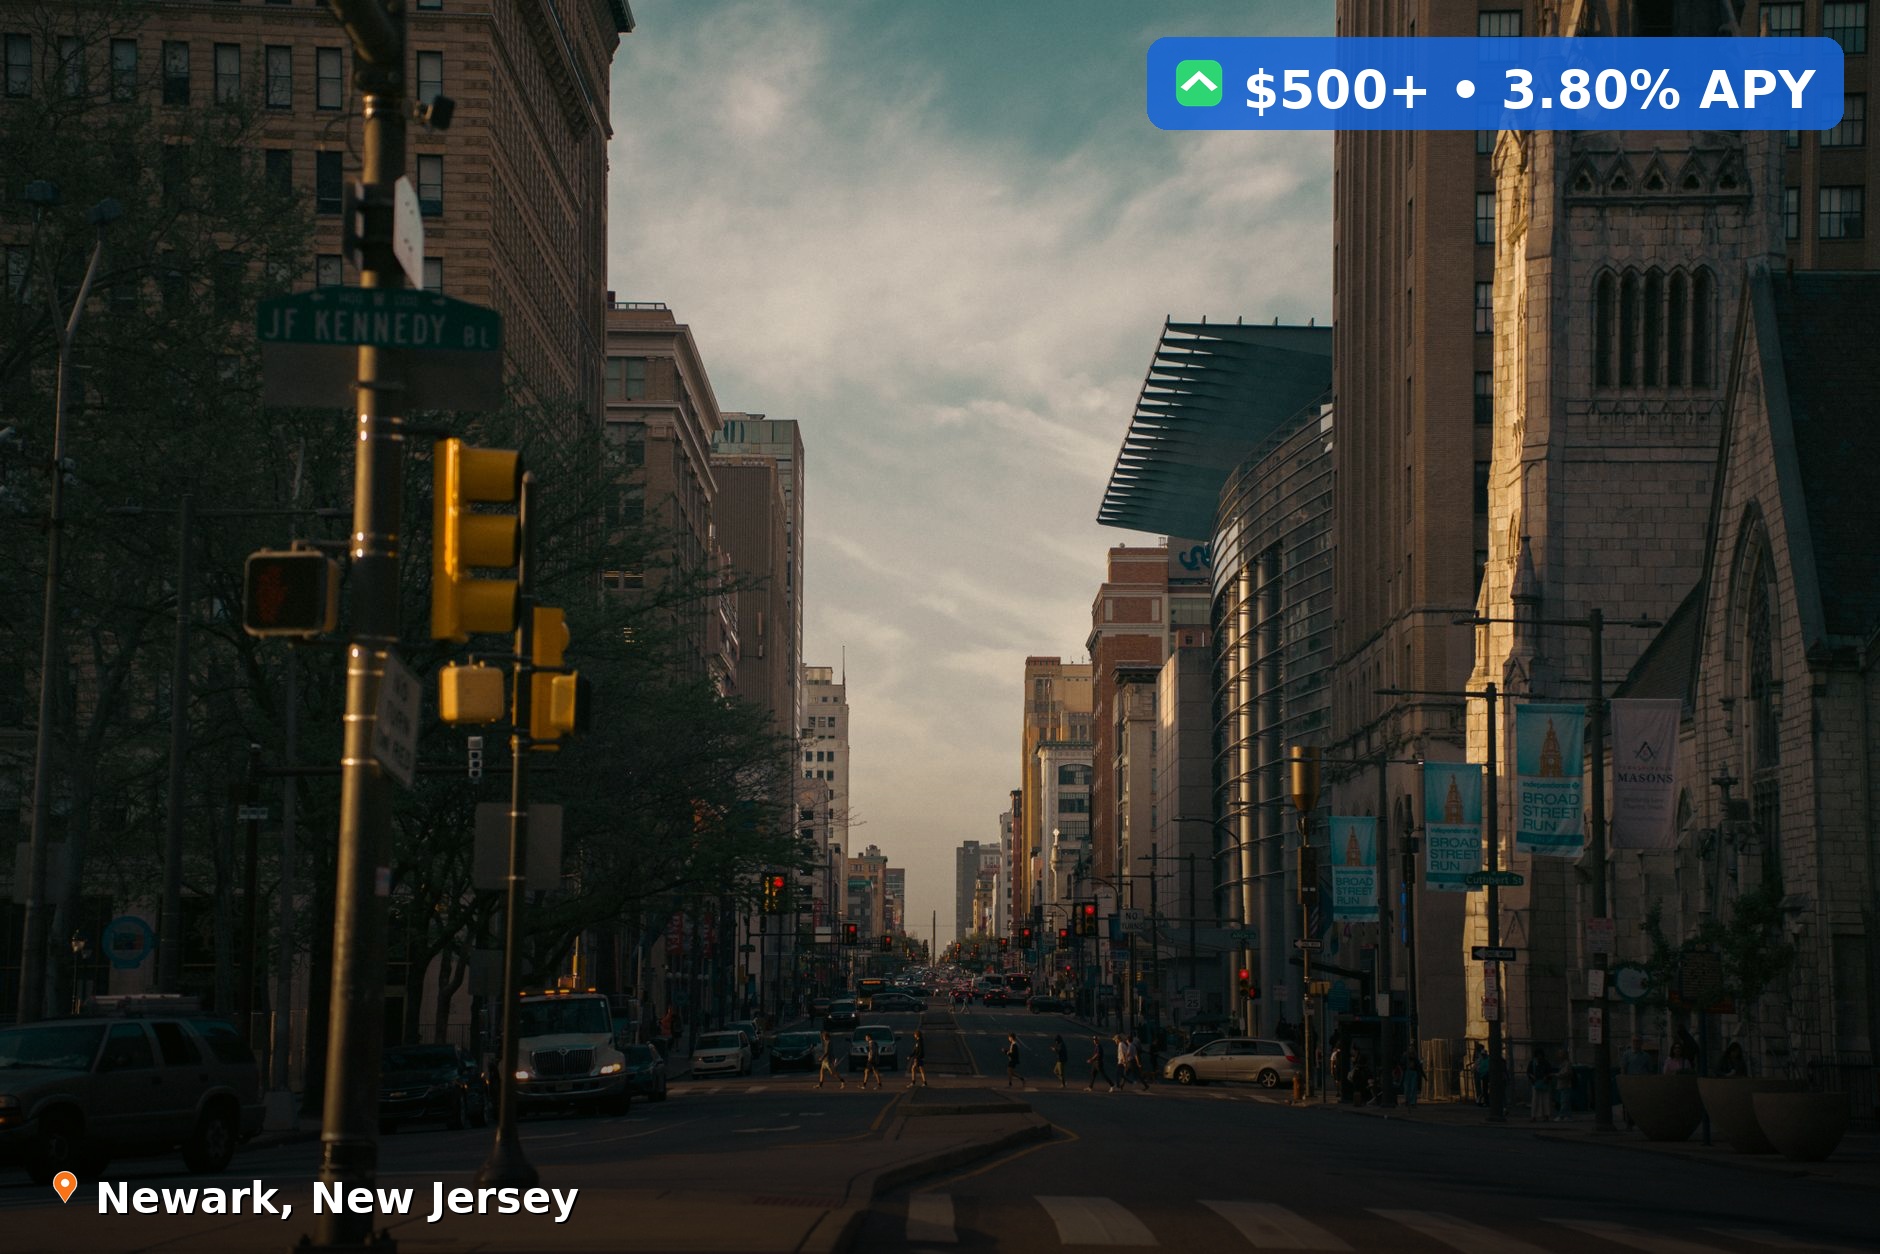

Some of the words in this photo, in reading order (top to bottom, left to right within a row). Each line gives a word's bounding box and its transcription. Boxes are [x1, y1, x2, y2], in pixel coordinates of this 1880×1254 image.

[265, 307, 299, 340] JF
[314, 309, 447, 344] KENNEDY
[462, 325, 490, 348] BL
[1617, 772, 1674, 784] MASONS
[1522, 791, 1580, 805] BROAD
[1522, 805, 1580, 819] STREET
[1522, 817, 1557, 832] RUN
[1430, 837, 1479, 848] BROAD
[1430, 848, 1480, 860] STREET
[1430, 860, 1460, 871] RUN
[1335, 877, 1374, 886] BROAD
[1466, 874, 1510, 885] Cuthbert
[1335, 886, 1374, 896] STREET
[1336, 896, 1360, 905] RUN
[1126, 912, 1138, 920] NO
[1186, 999, 1199, 1008] 25
